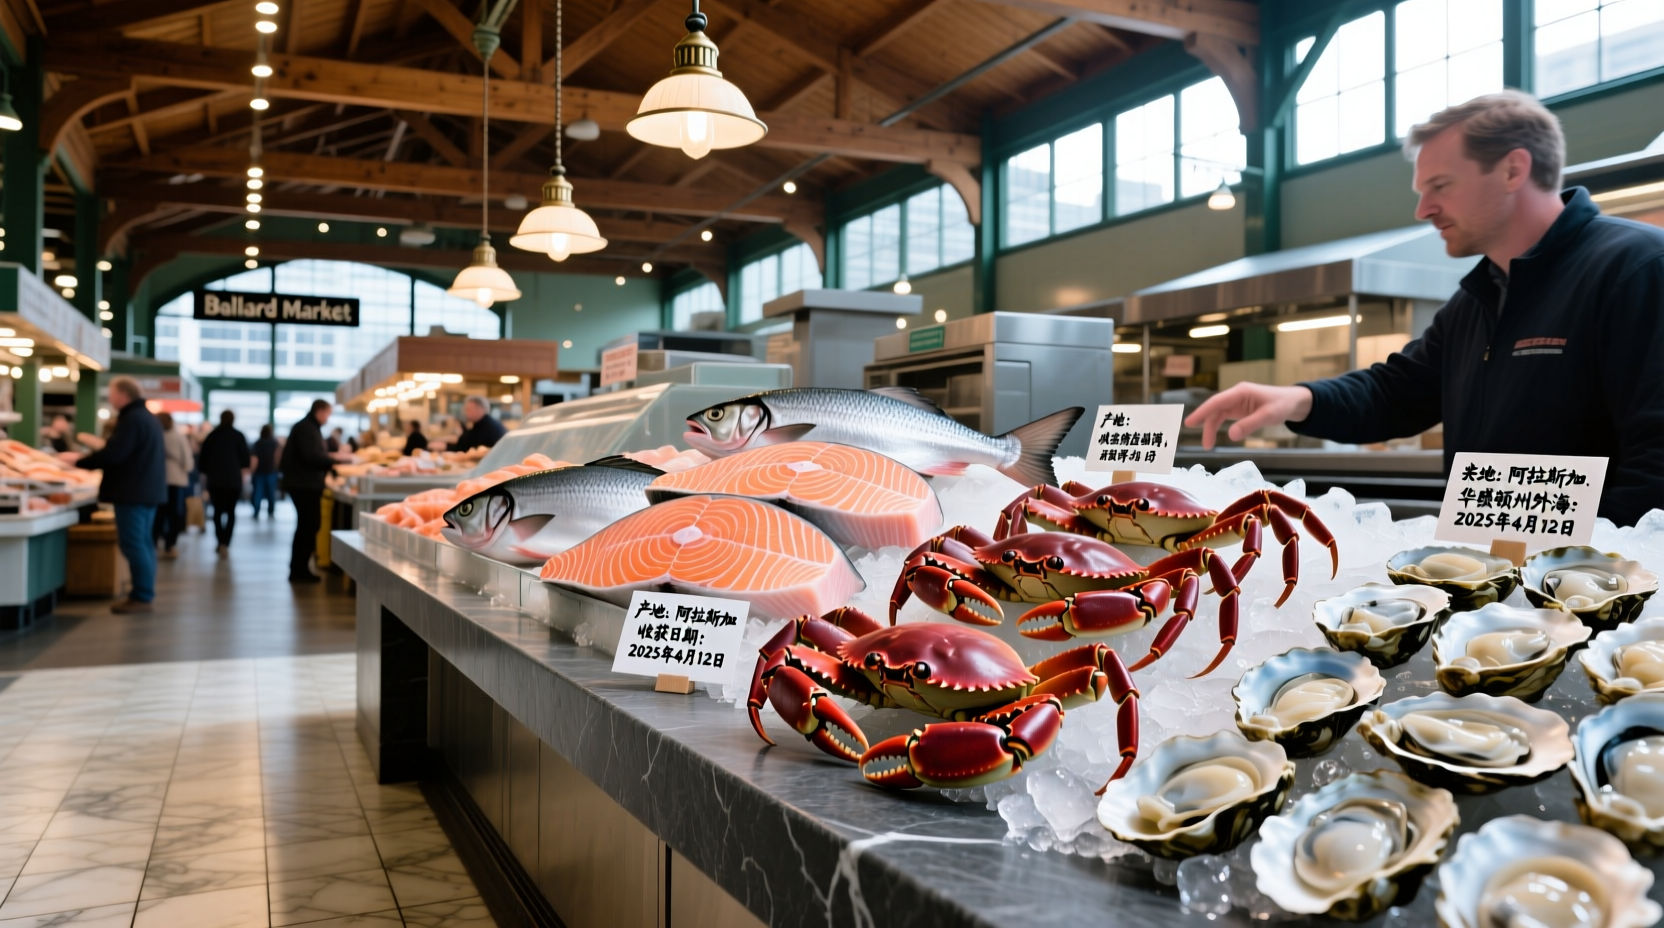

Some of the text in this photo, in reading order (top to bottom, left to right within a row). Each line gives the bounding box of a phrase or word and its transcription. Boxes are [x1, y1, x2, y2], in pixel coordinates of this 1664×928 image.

[204, 294, 352, 322] Ballard Market
[1454, 512, 1575, 537] 2025年4月12日
[675, 605, 738, 627] 阿拉斯加
[637, 623, 705, 646] 收获日期:
[628, 644, 725, 668] 2025年4月12日
